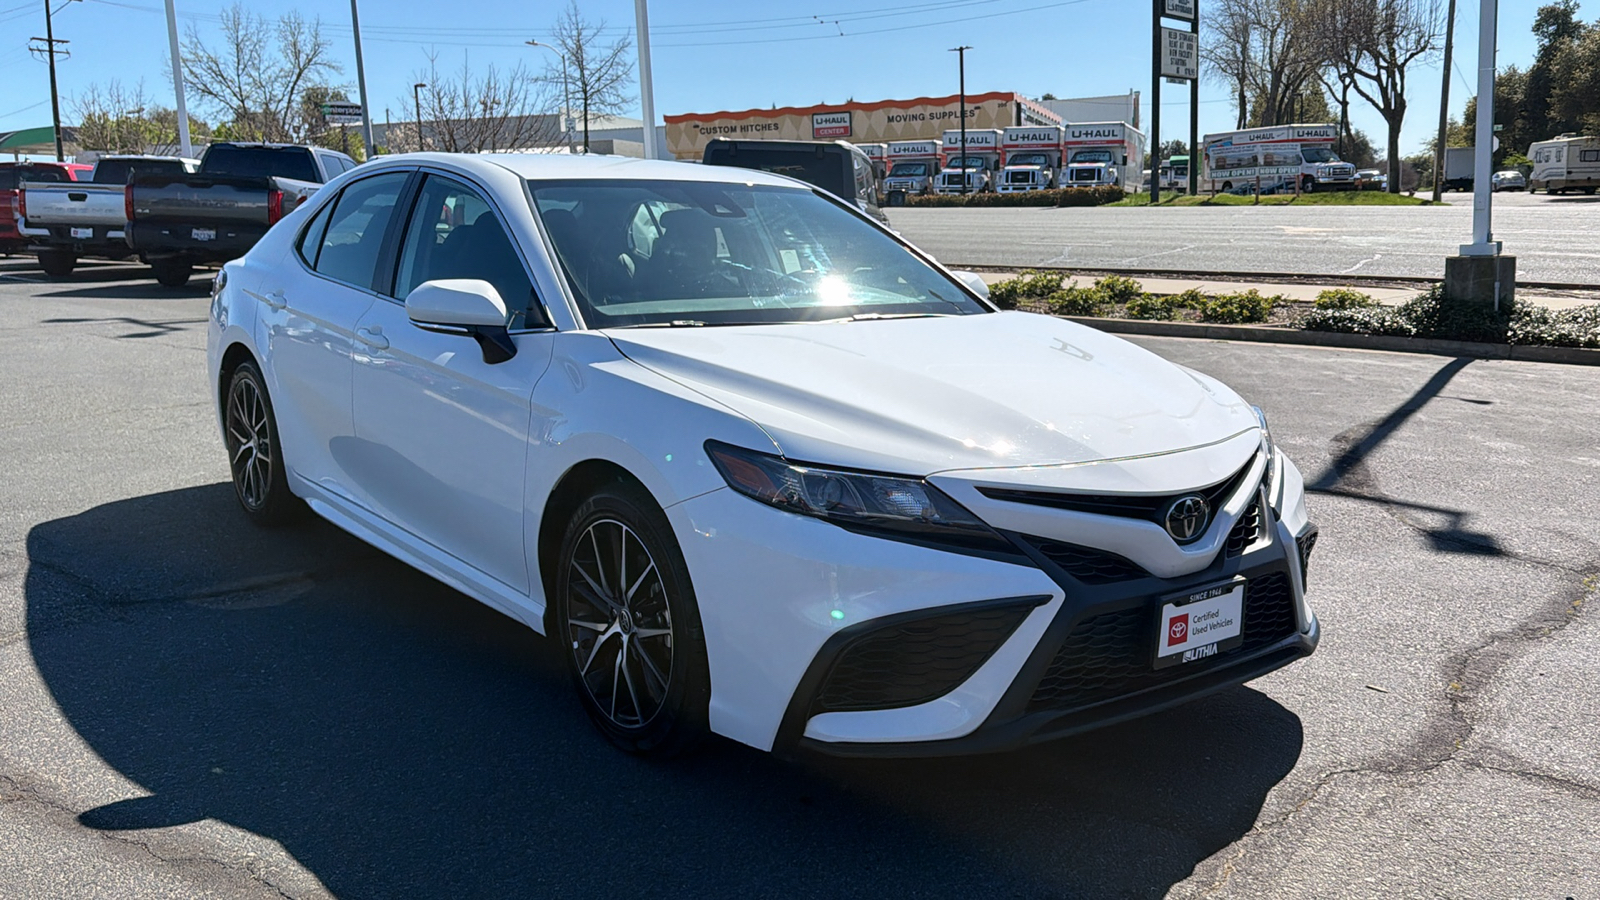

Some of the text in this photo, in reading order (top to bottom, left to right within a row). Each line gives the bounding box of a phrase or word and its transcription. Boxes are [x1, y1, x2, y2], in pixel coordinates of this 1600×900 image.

[816, 116, 848, 125] U-HAUL
[887, 109, 975, 123] MOVING SUPPLES
[699, 122, 779, 135] CUSTOM HITCHES
[1009, 133, 1054, 142] U-HAUL
[1071, 129, 1119, 138] U-HAUL
[1249, 132, 1275, 141] U-HAUL
[1297, 130, 1330, 138] U-HAUL
[893, 146, 929, 154] U-HAUL
[1211, 170, 1231, 178] NOW
[1260, 166, 1298, 175] NOW OPEN!
[1189, 588, 1222, 602] SINCE 1946
[1193, 609, 1219, 624] Certified
[1192, 617, 1233, 636] Used Vehicles
[1190, 642, 1218, 662] LITHIA
